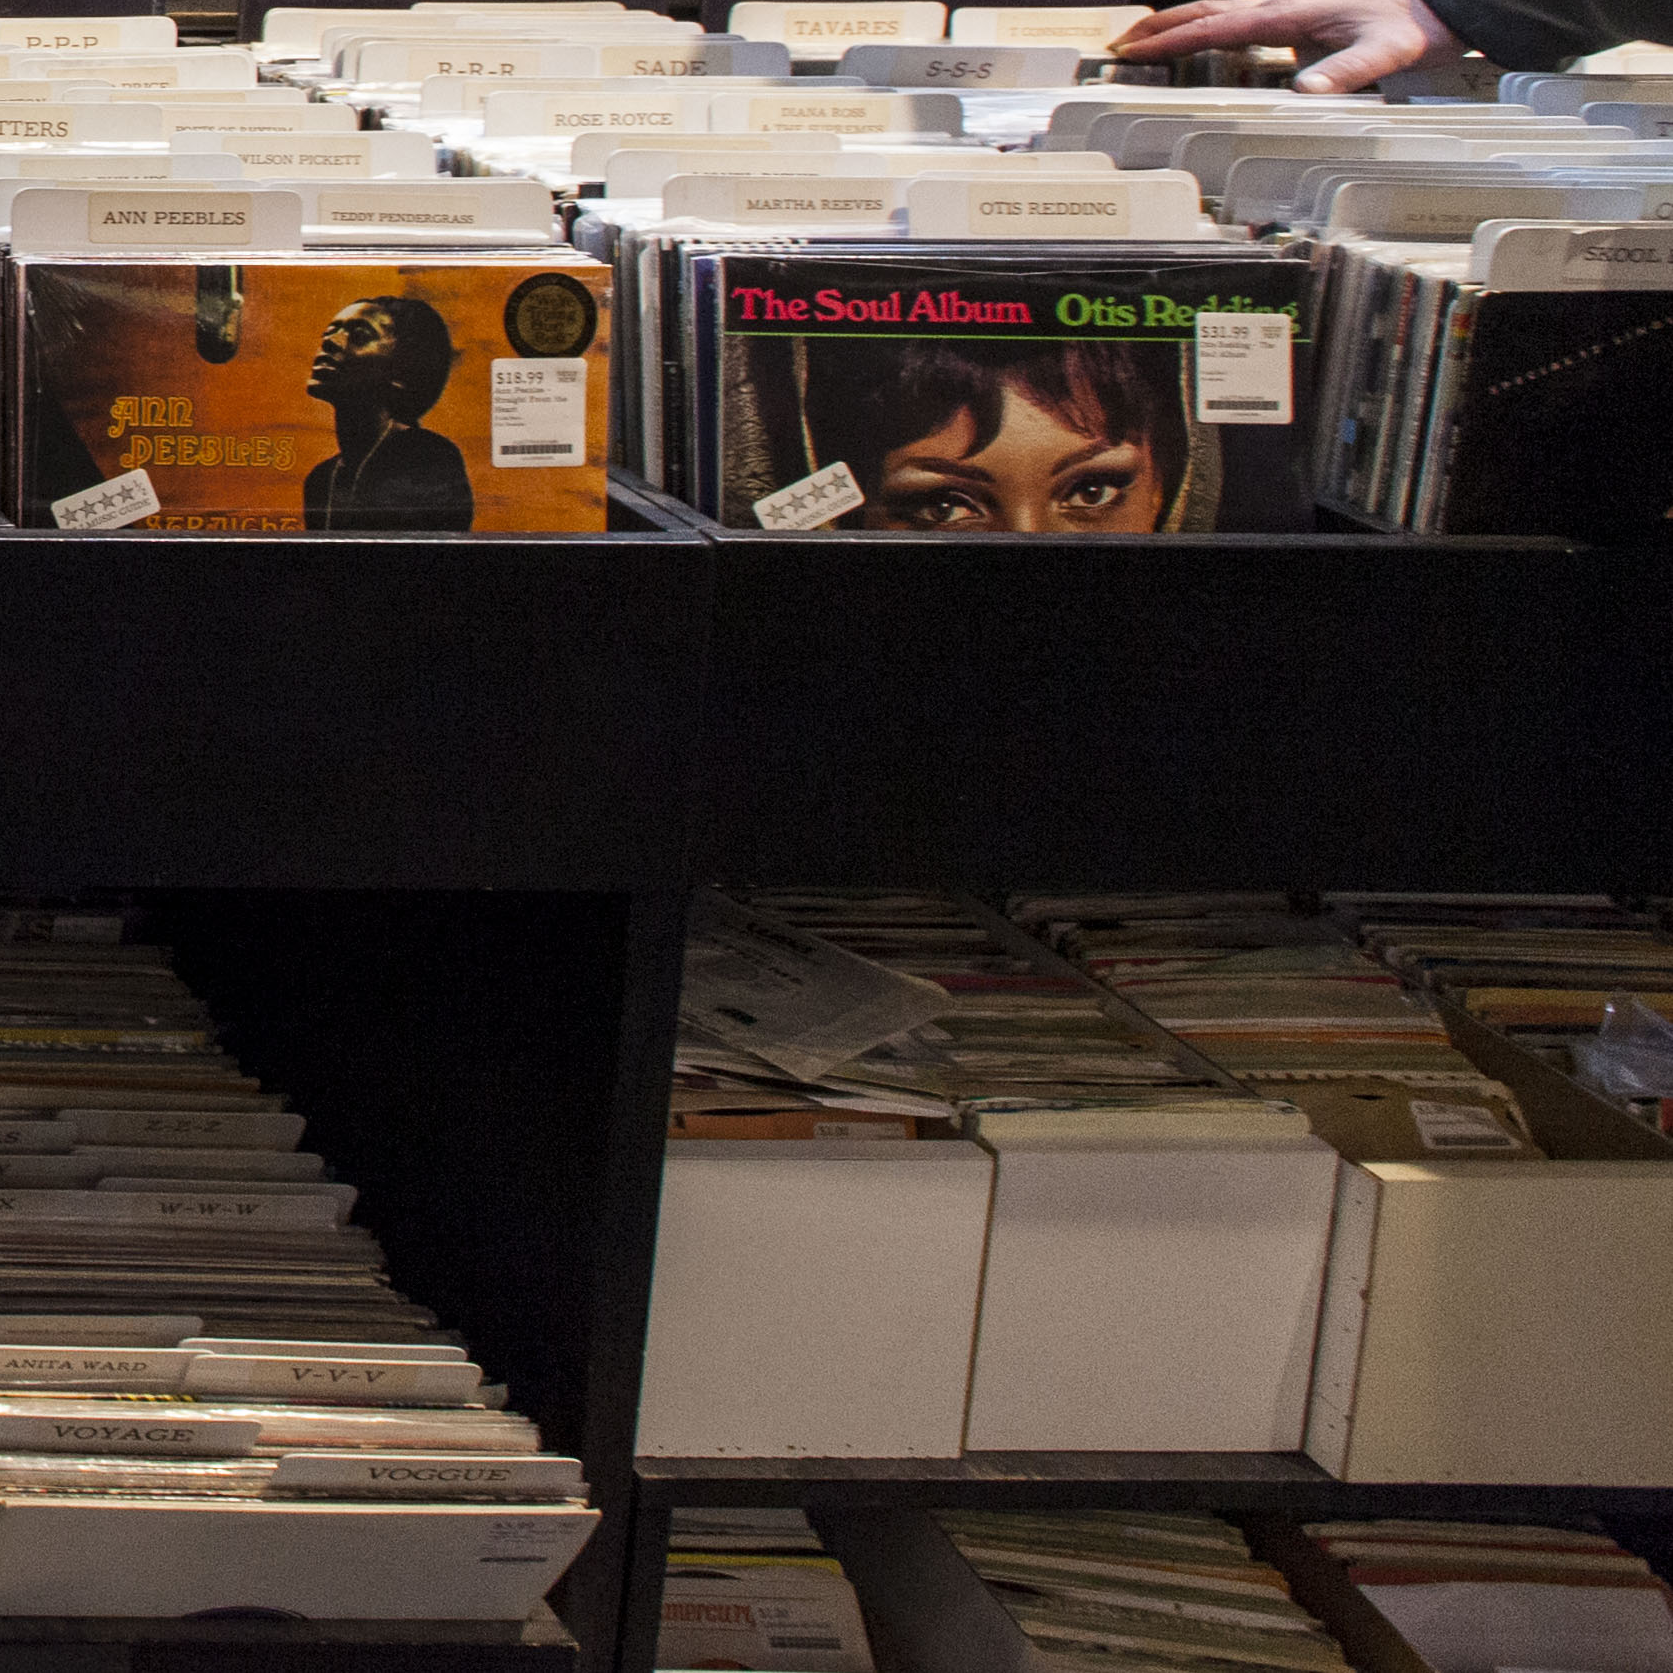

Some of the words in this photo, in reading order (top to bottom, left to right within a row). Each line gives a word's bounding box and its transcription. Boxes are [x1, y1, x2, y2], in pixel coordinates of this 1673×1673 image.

[795, 20, 900, 37] TAVARES
[632, 59, 707, 77] SADE
[103, 210, 148, 225] ANN
[154, 210, 246, 225] PEEBLES
[980, 202, 1023, 217] OTIS
[1028, 202, 1118, 217] REDDING
[732, 287, 808, 322] The
[815, 289, 902, 322] Soul
[906, 290, 1033, 325] Album
[1056, 293, 1136, 328] Otis
[55, 1425, 198, 1444] VOYAGE
[368, 1466, 513, 1483] VOGGUE
